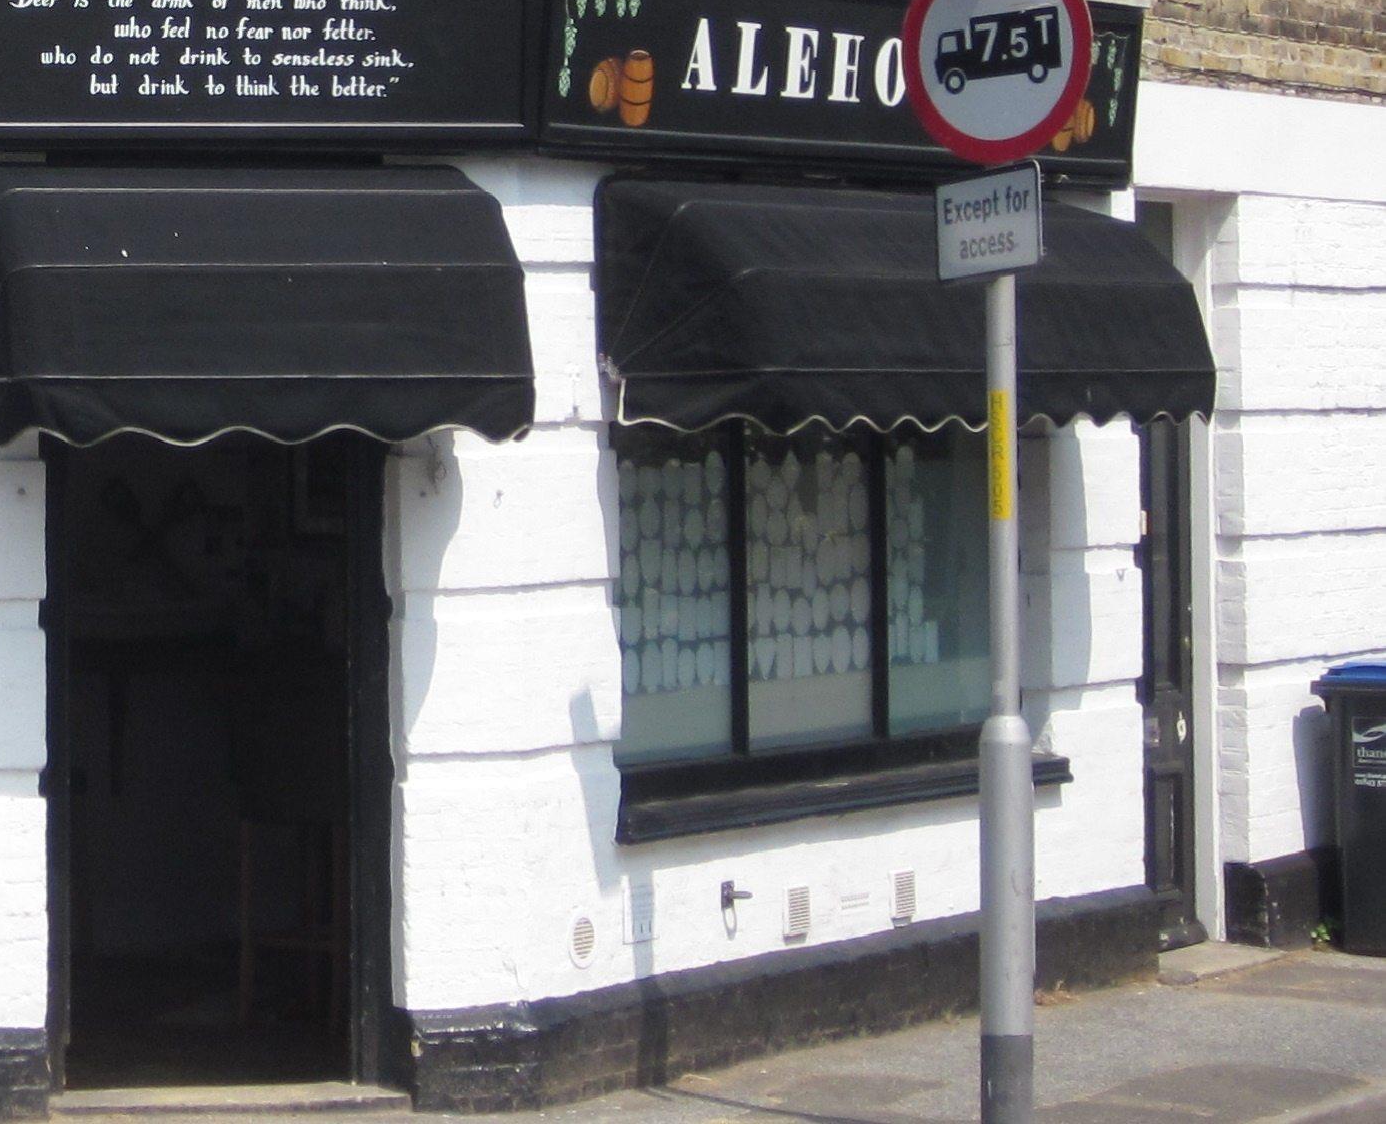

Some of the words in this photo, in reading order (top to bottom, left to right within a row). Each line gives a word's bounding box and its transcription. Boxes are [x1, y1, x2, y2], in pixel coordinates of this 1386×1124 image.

[114, 16, 152, 38] who
[160, 16, 191, 39] feel
[206, 25, 230, 39] no
[235, 16, 274, 40] fear
[281, 26, 312, 41] nor
[322, 18, 376, 41] fetter.
[40, 45, 77, 65] who
[89, 45, 114, 65] do
[128, 46, 160, 66] not
[179, 47, 231, 66] drink
[241, 46, 262, 66] to
[272, 47, 355, 67] senseless
[362, 48, 414, 68] sink,
[680, 17, 907, 107] ALEHO
[89, 73, 120, 95] but
[138, 73, 190, 96] drink
[204, 74, 226, 96] to
[235, 74, 280, 97] think
[288, 74, 320, 97] the
[943, 189, 999, 225] Except
[1005, 186, 1029, 214] for
[959, 231, 1015, 260] access
